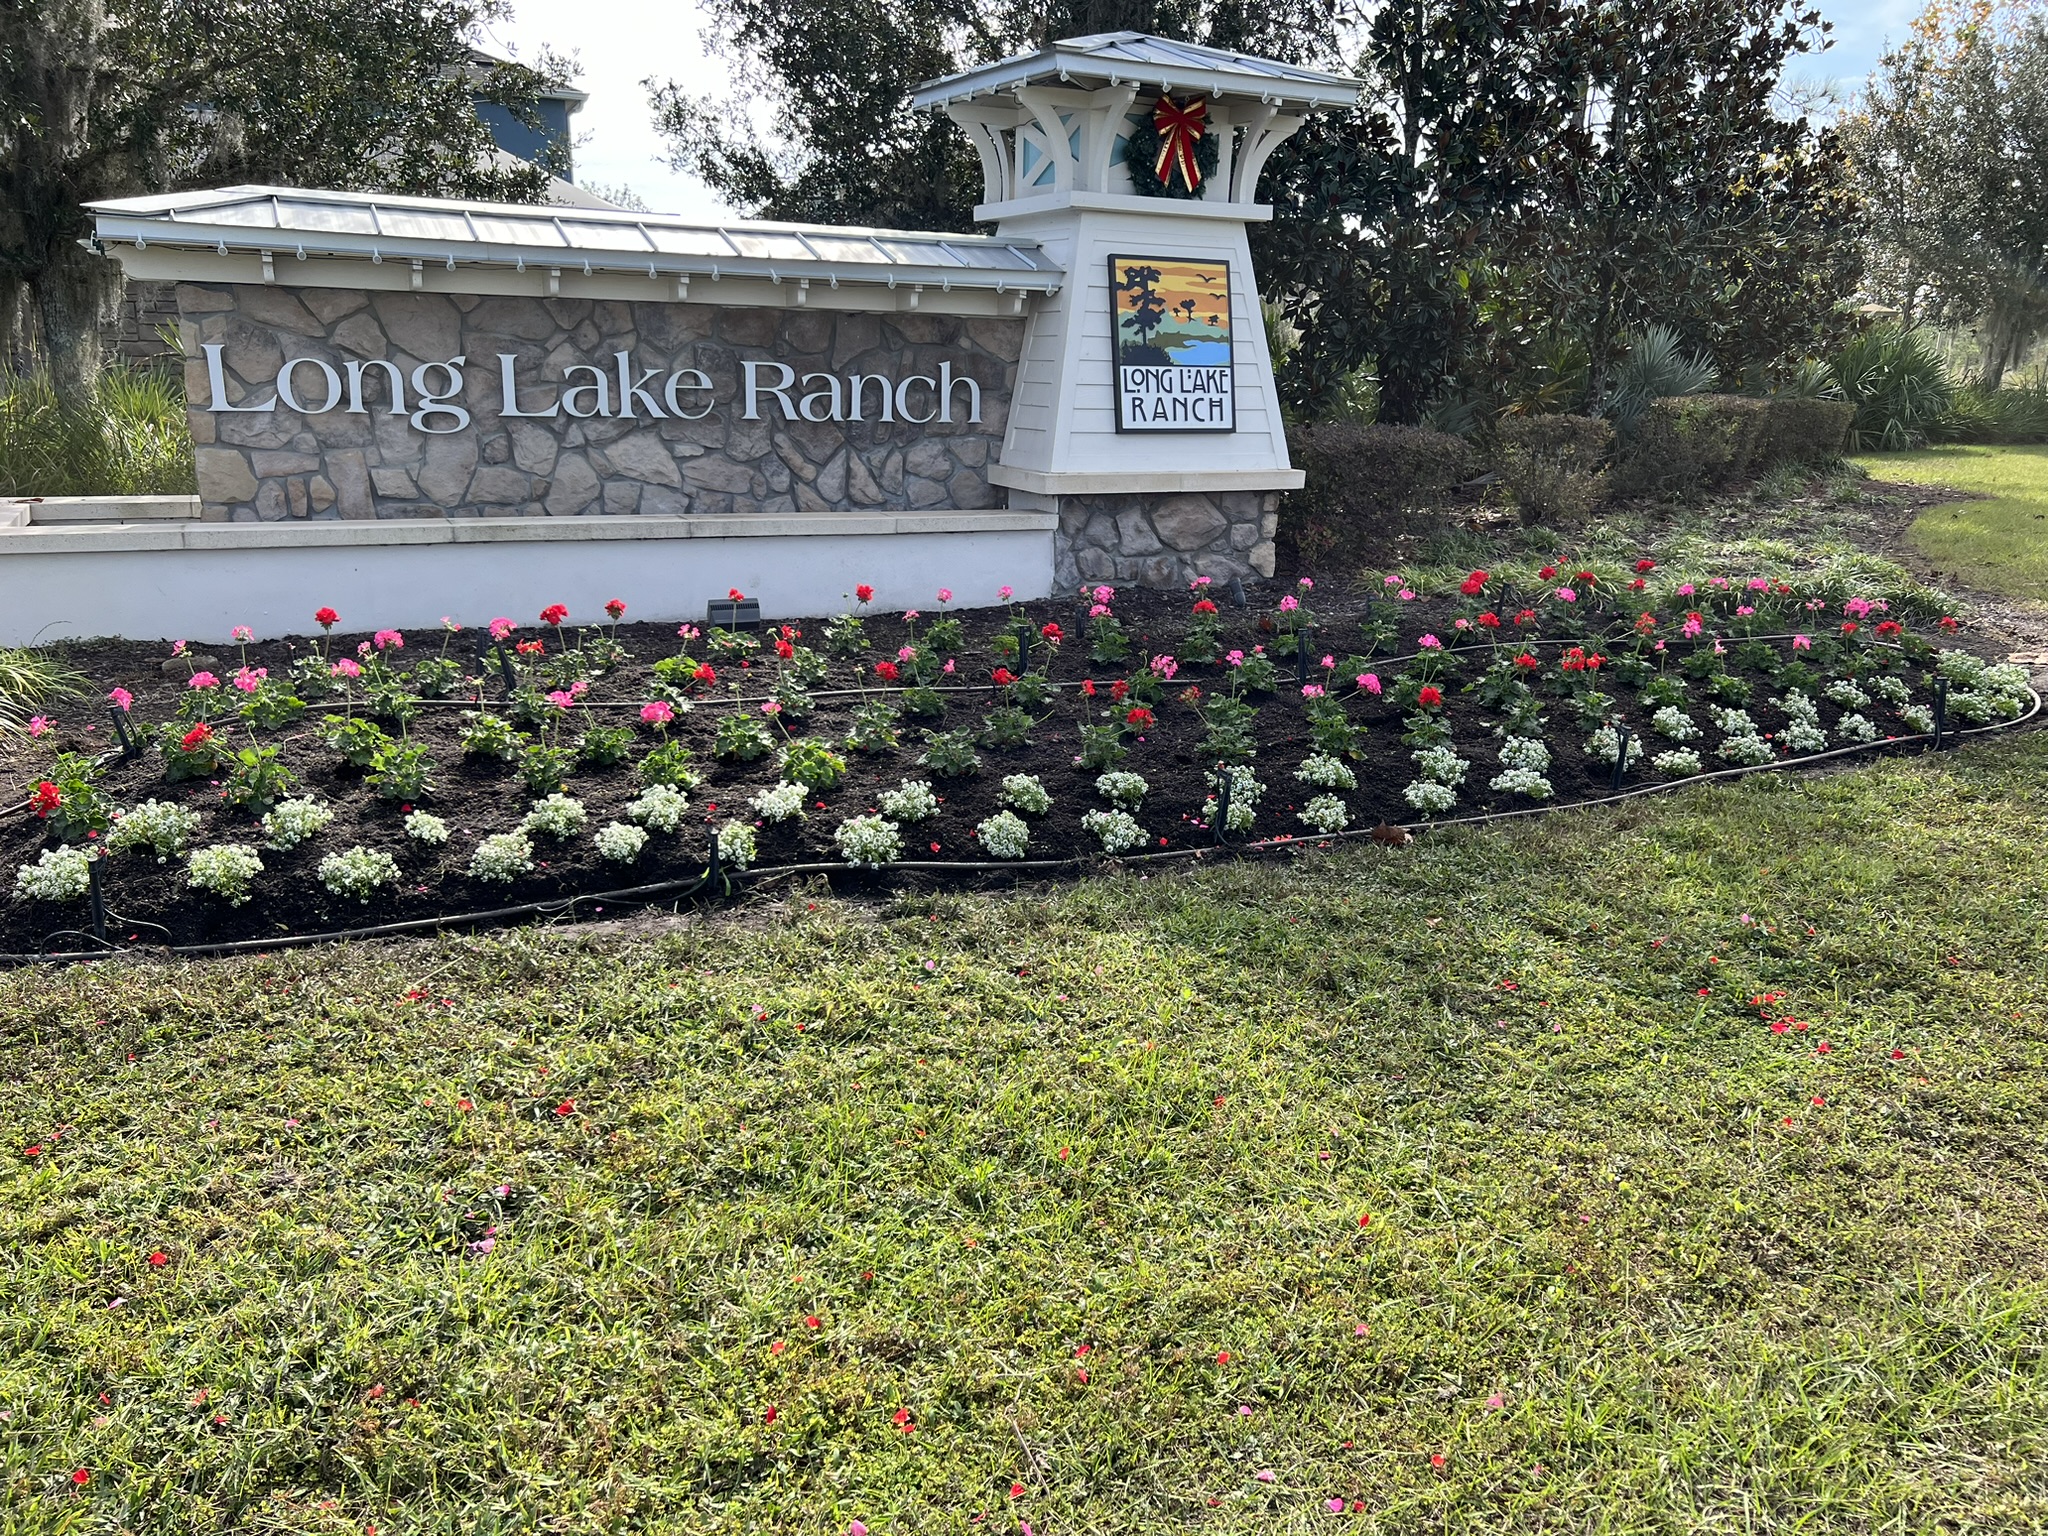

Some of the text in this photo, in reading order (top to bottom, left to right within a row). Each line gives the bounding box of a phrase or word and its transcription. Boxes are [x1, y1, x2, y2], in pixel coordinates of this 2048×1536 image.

[200, 343, 983, 434] Long Lake Ranch
[1123, 368, 1229, 394] LONG LAKE
[1131, 396, 1224, 422] RANCH
